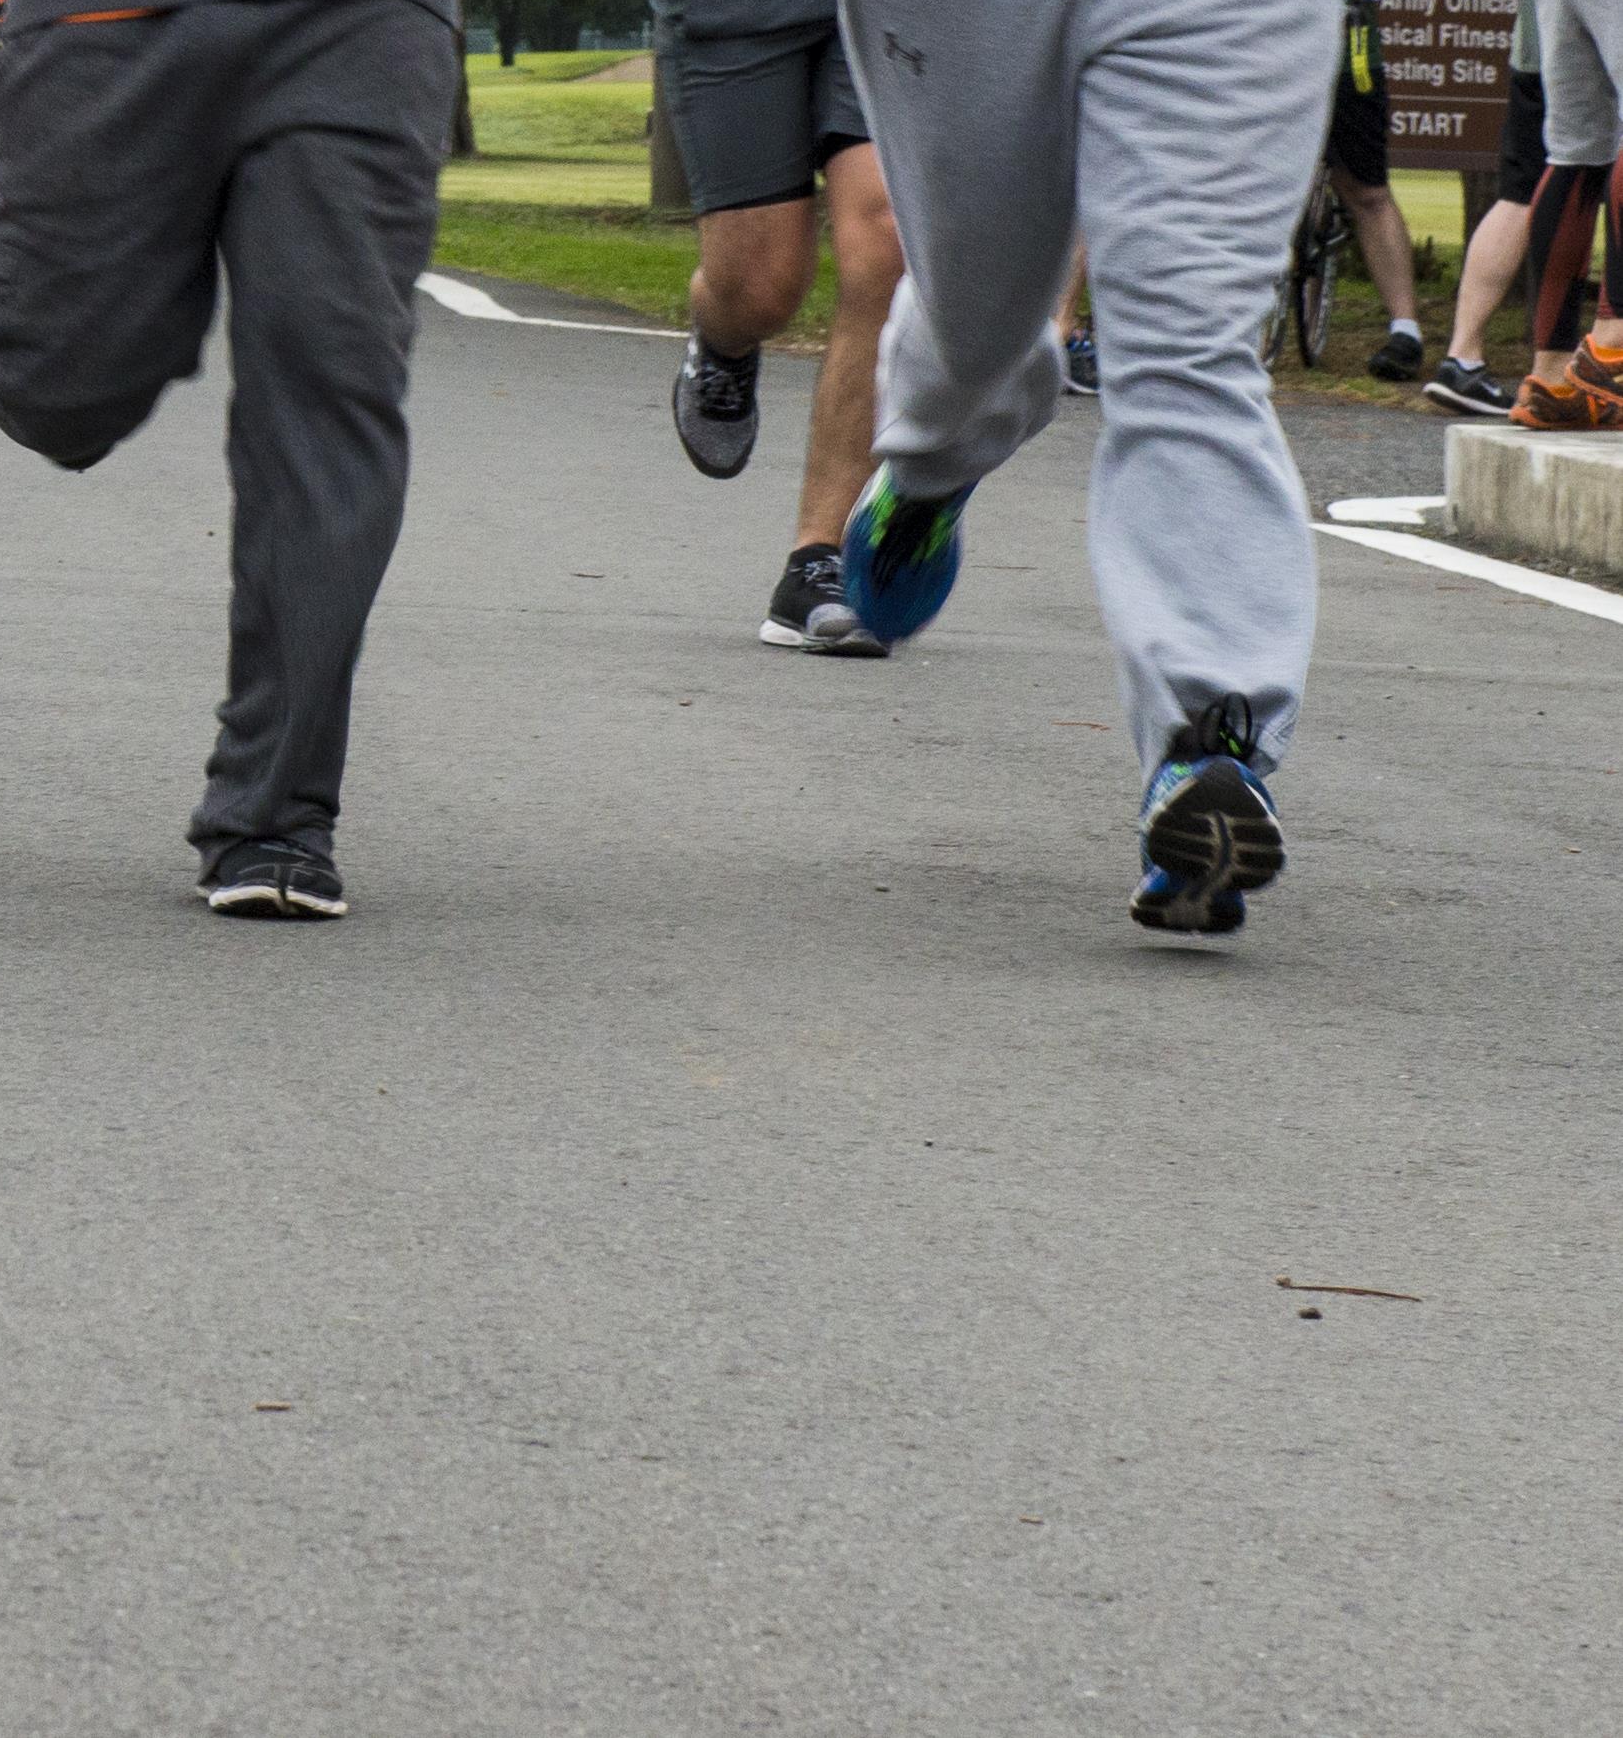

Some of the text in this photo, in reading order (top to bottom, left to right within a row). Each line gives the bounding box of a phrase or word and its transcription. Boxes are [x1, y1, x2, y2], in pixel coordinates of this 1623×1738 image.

[1380, 22, 1513, 49] sical Fitnes
[1453, 59, 1497, 83] Site
[1391, 111, 1467, 136] START
